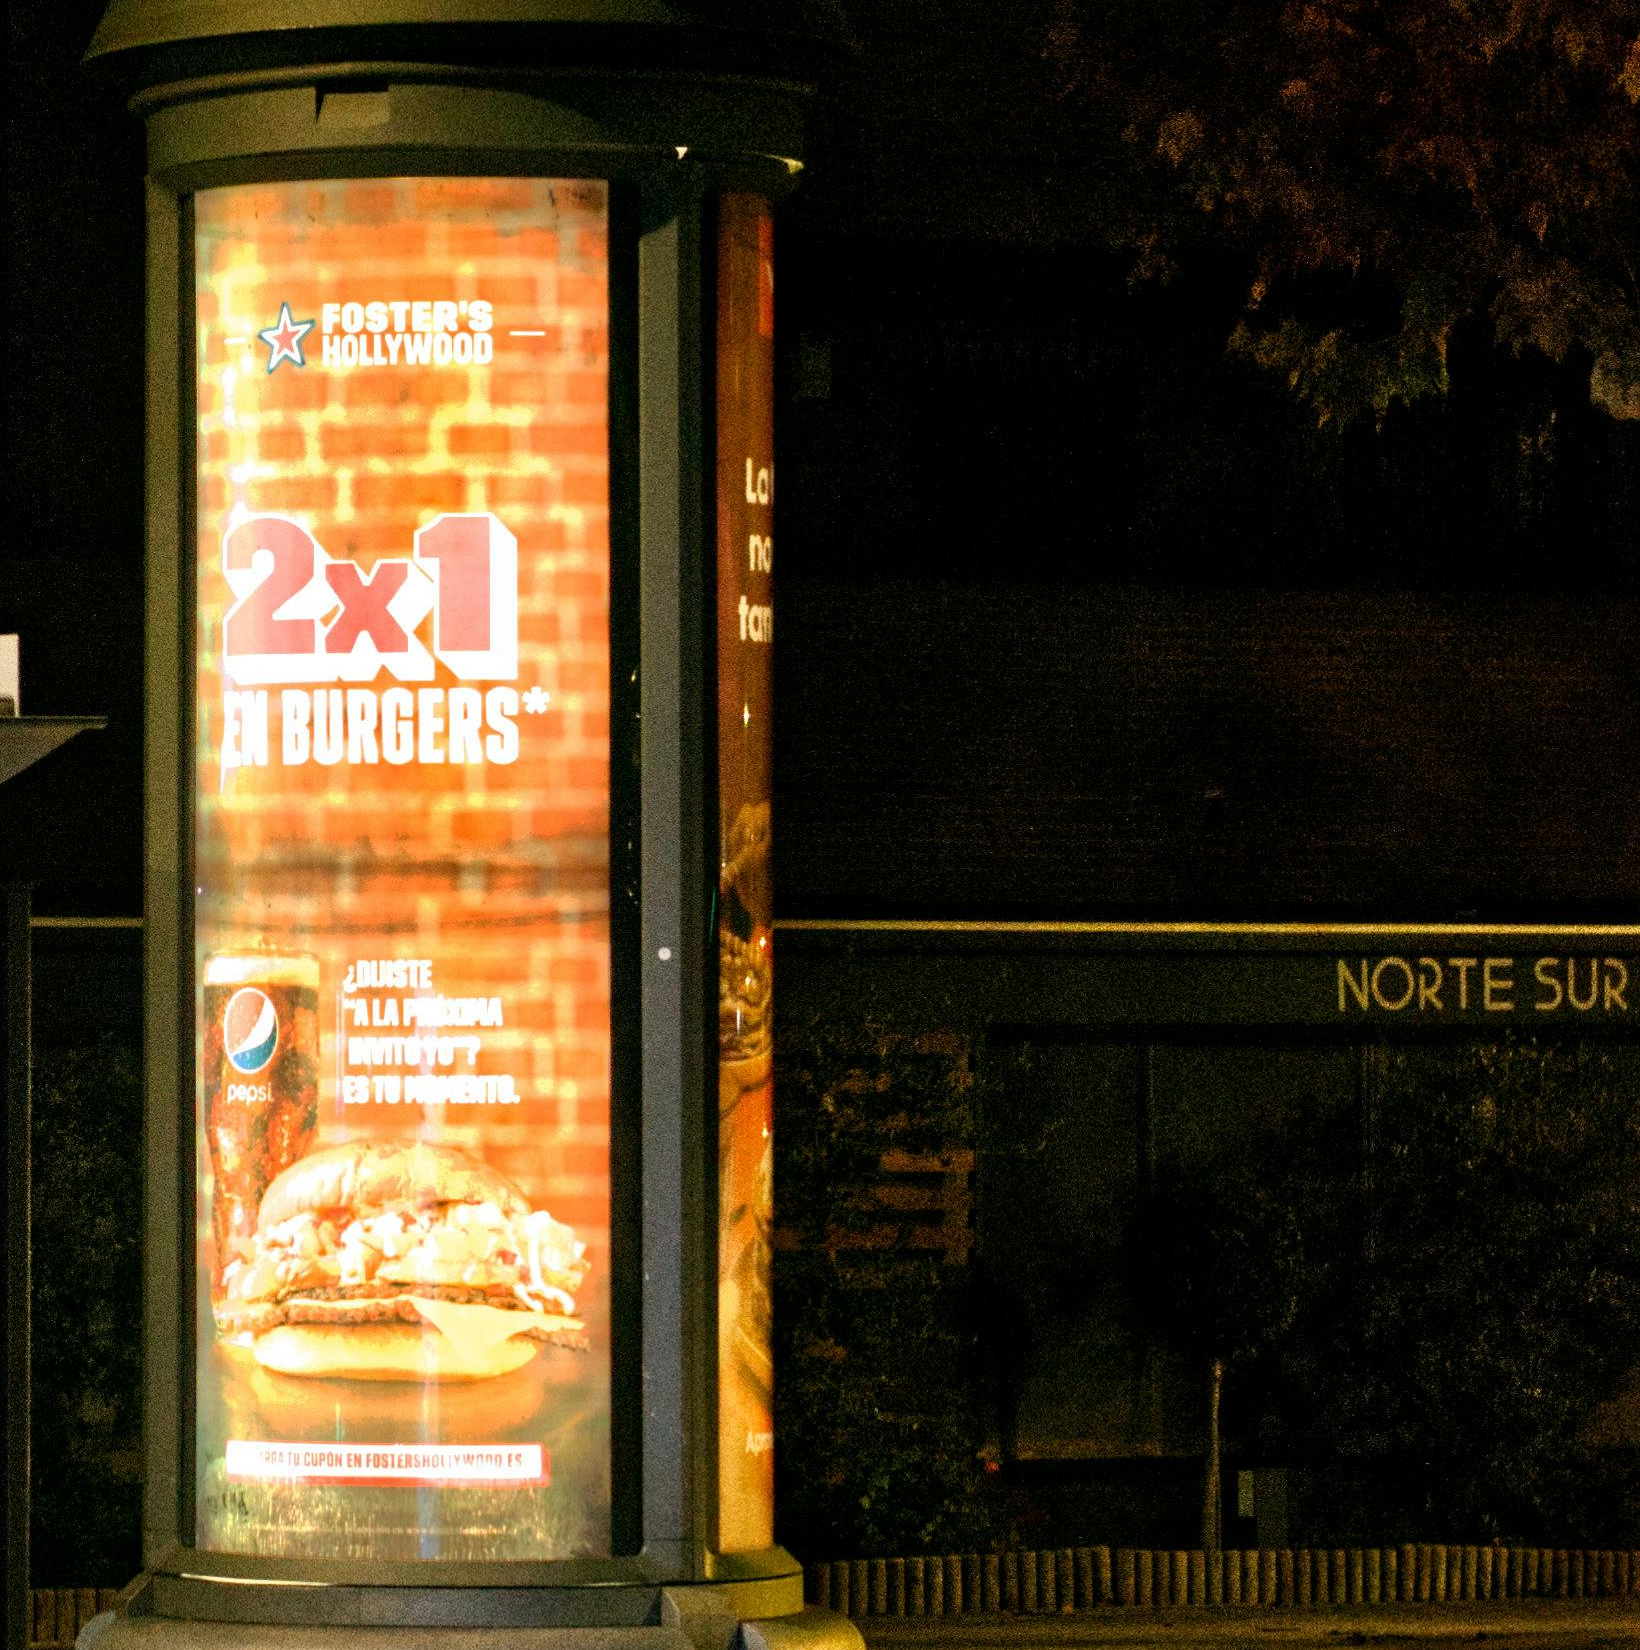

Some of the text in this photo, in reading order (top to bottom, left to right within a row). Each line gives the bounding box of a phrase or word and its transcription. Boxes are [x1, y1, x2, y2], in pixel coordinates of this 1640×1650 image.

[321, 301, 493, 332] FOSTER'S
[321, 333, 493, 368] HOLLYWOOD
[223, 512, 518, 684] 2x1
[1336, 956, 1628, 1012] NORTE SUR
[372, 999, 399, 1026] LA
[227, 1082, 272, 1106] pepsi
[343, 1075, 369, 1103] ES
[373, 1076, 400, 1103] TU
[288, 1451, 300, 1466] TU
[303, 1450, 342, 1467] CUPÓN
[346, 1452, 362, 1468] EN
